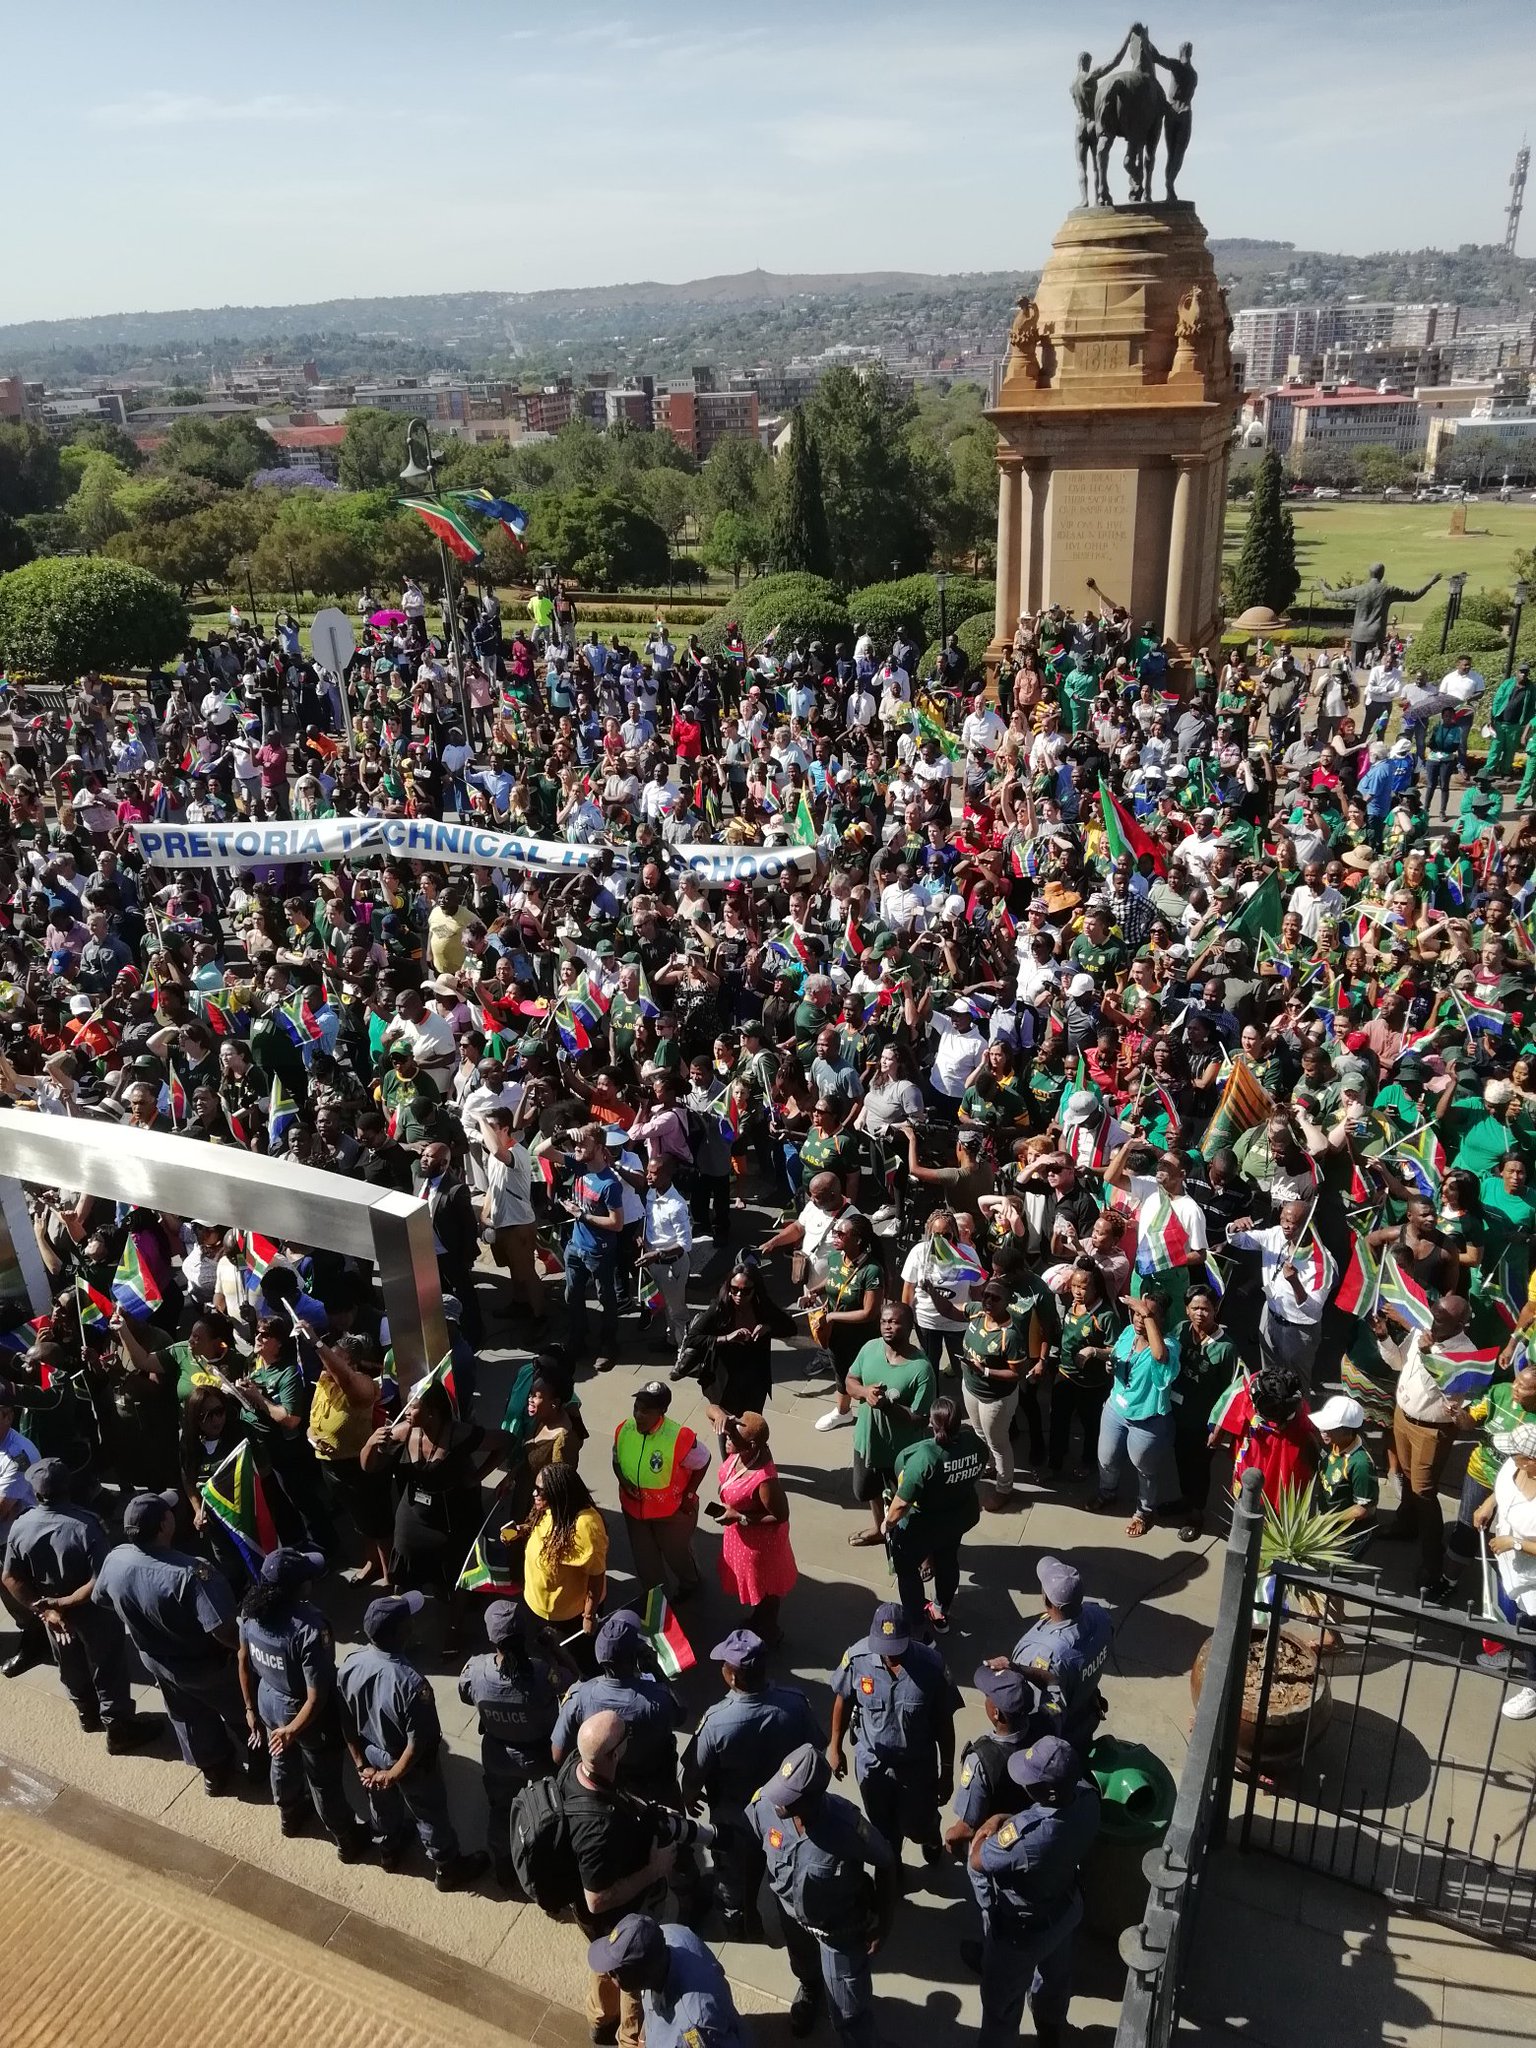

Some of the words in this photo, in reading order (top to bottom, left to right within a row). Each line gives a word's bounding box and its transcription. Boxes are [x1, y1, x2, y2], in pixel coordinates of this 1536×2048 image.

[139, 827, 324, 859] PRETORIA
[336, 819, 548, 865] TECHNICAL
[561, 850, 641, 874] HG
[622, 1022, 638, 1030] ABS
[943, 1452, 978, 1474] SOUTH
[250, 1641, 285, 1671] POLICE
[1081, 1644, 1108, 1682] POLICE
[484, 1709, 529, 1724] POLICE
